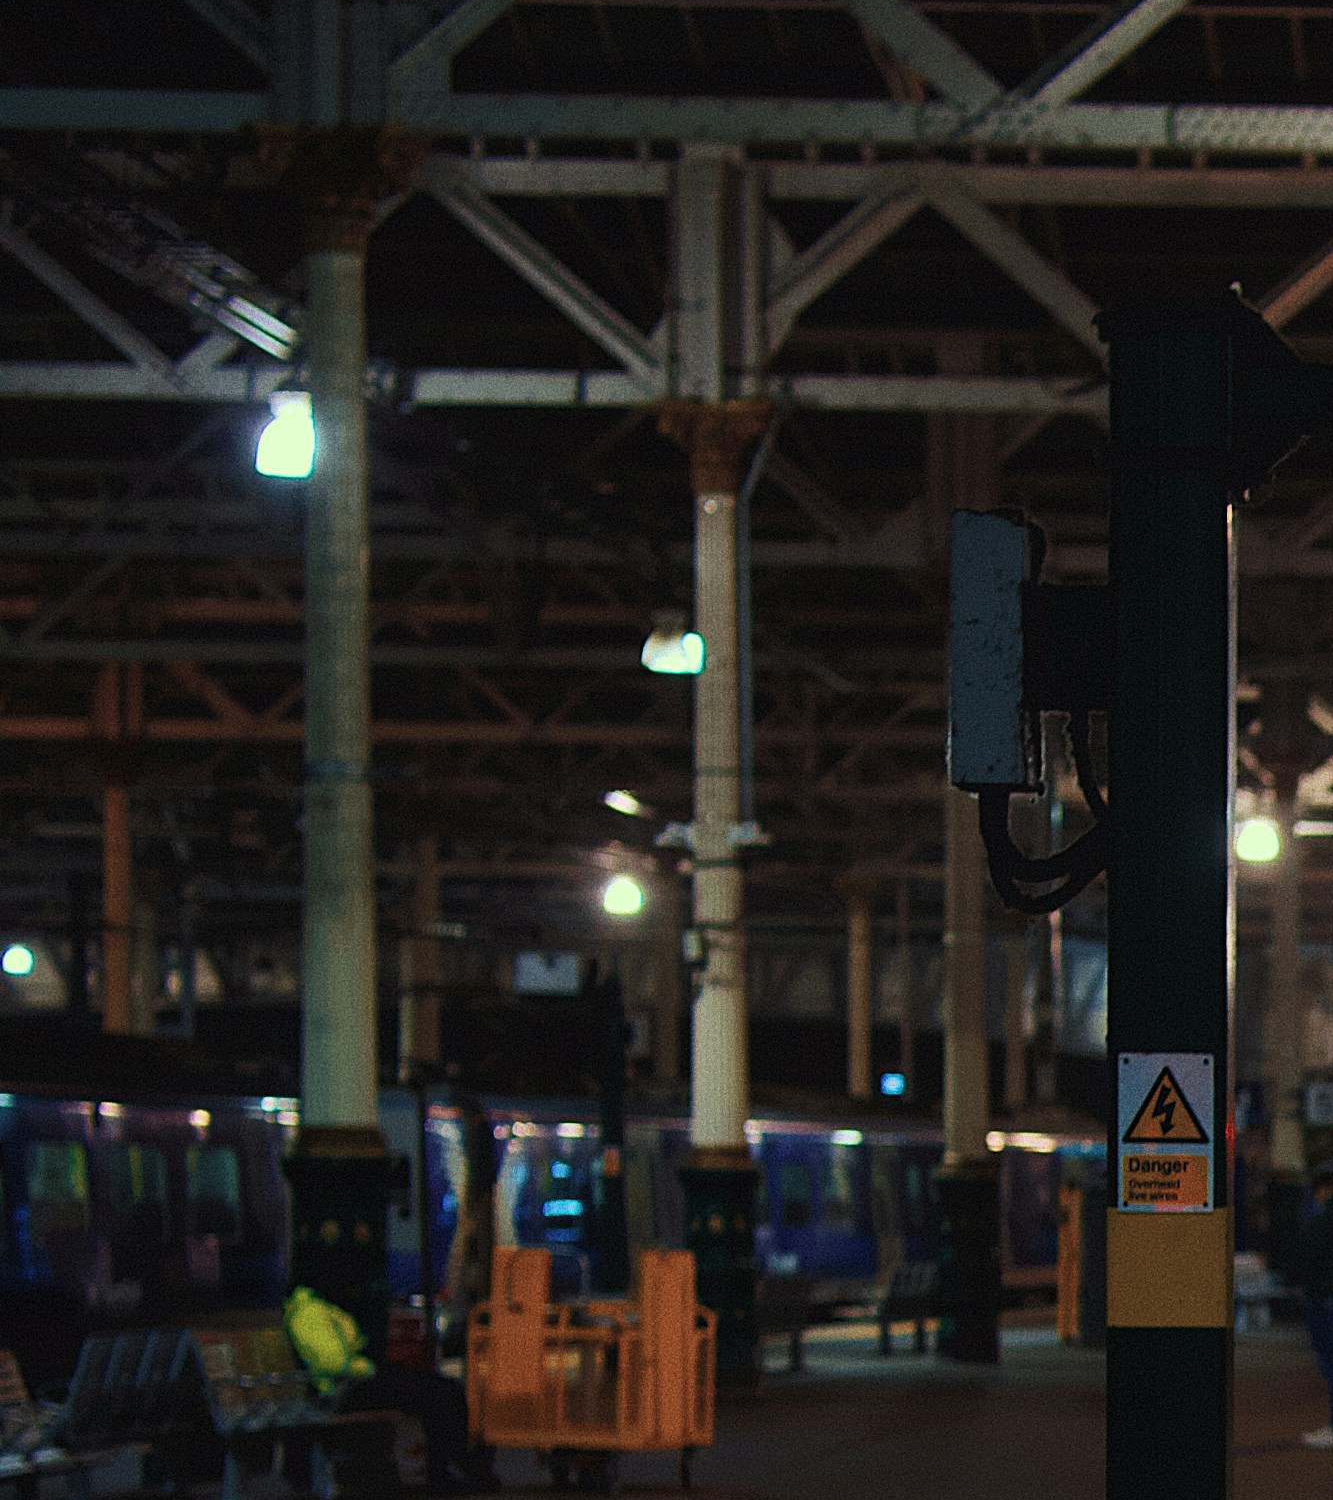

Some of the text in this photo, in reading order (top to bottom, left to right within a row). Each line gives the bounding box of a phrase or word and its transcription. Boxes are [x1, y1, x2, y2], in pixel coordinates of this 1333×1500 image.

[1129, 1157, 1190, 1175] Danger
[1129, 1179, 1181, 1189] Overhead
[1129, 1191, 1179, 1201] live wires
